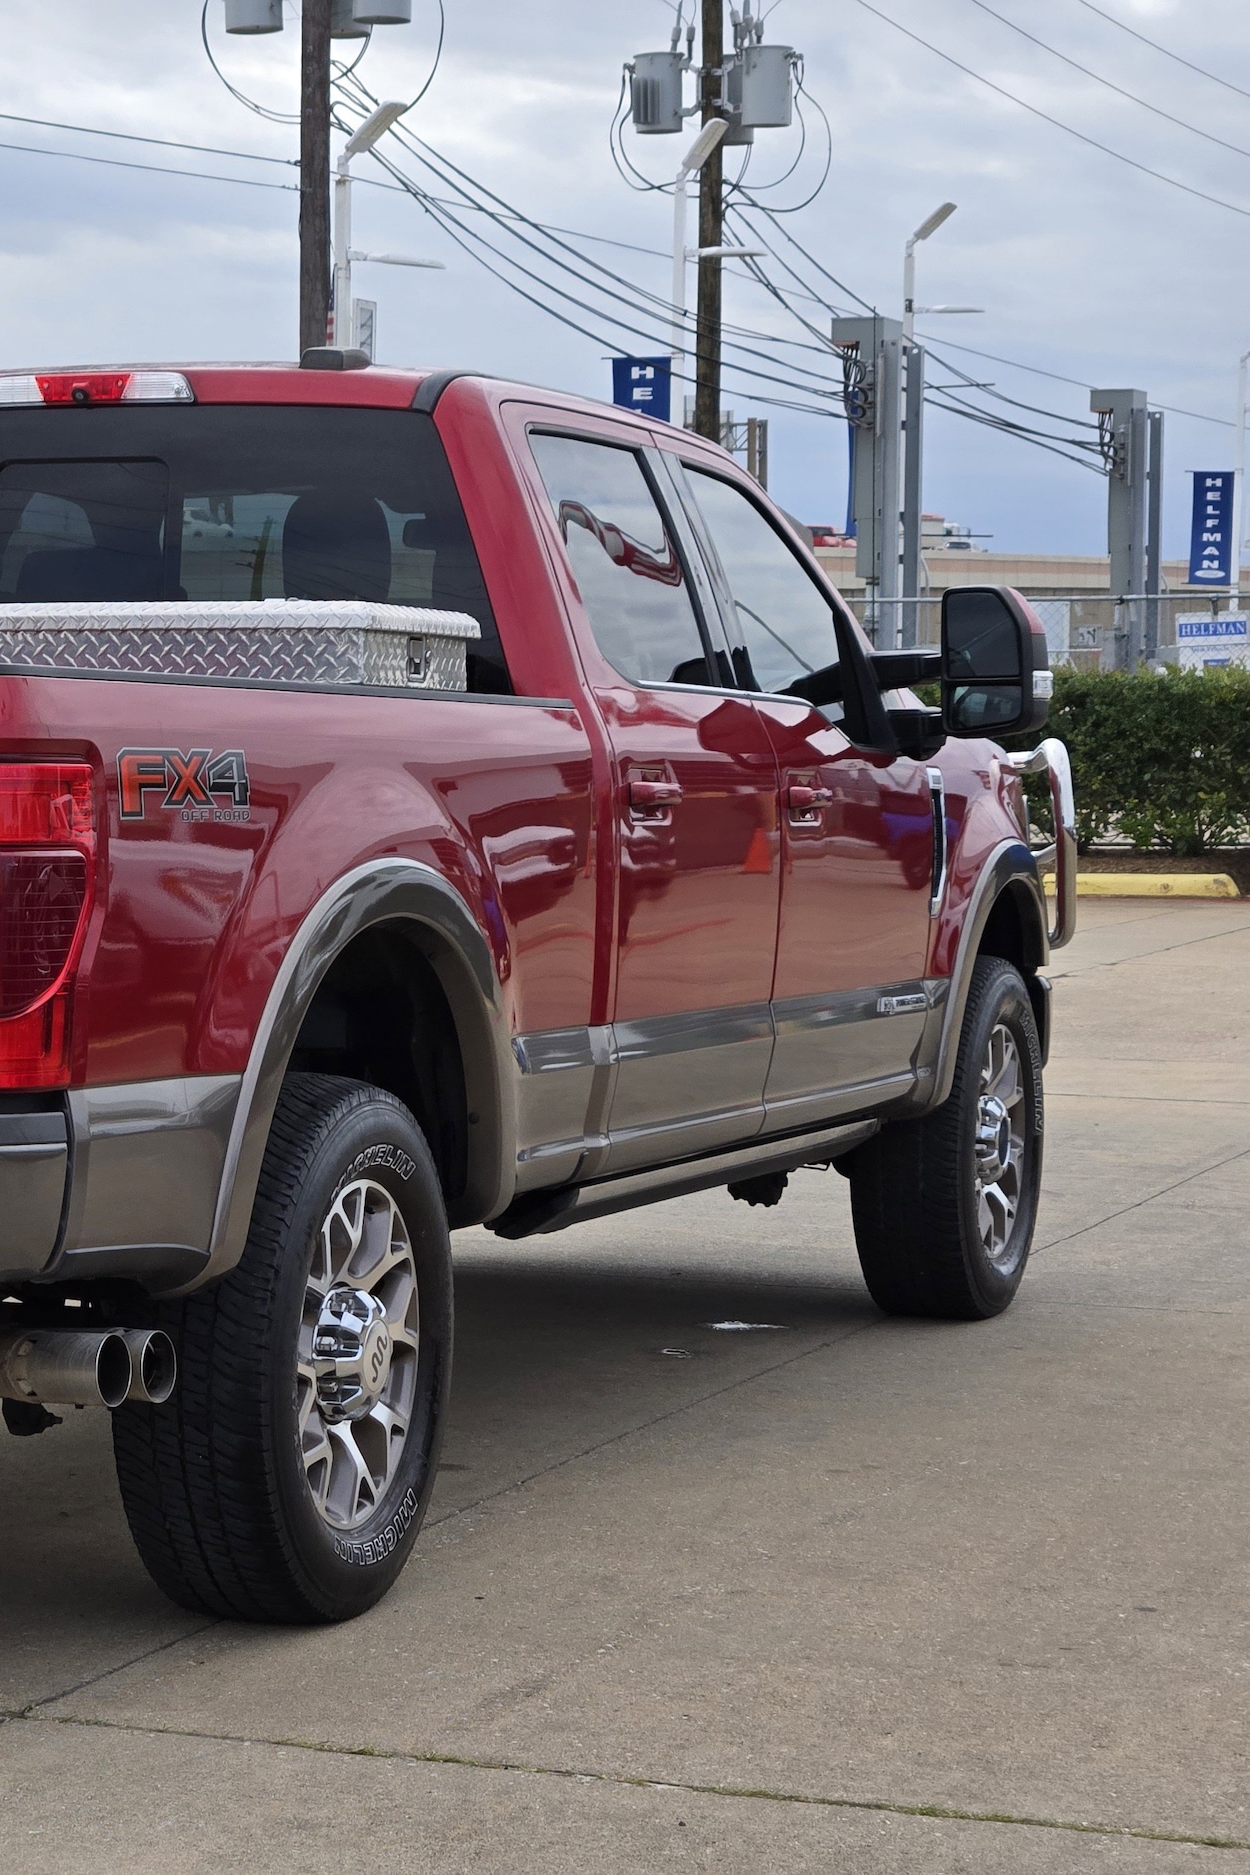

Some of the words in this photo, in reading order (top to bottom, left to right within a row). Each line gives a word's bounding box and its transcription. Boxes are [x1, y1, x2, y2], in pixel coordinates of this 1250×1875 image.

[631, 366, 654, 413] HE
[1201, 478, 1222, 569] HELFMAN
[1181, 622, 1245, 635] HELFMAN
[116, 747, 250, 820] FX4
[181, 809, 210, 822] OFF
[214, 809, 250, 822] ROAD
[334, 1488, 418, 1565] MICHELIN
